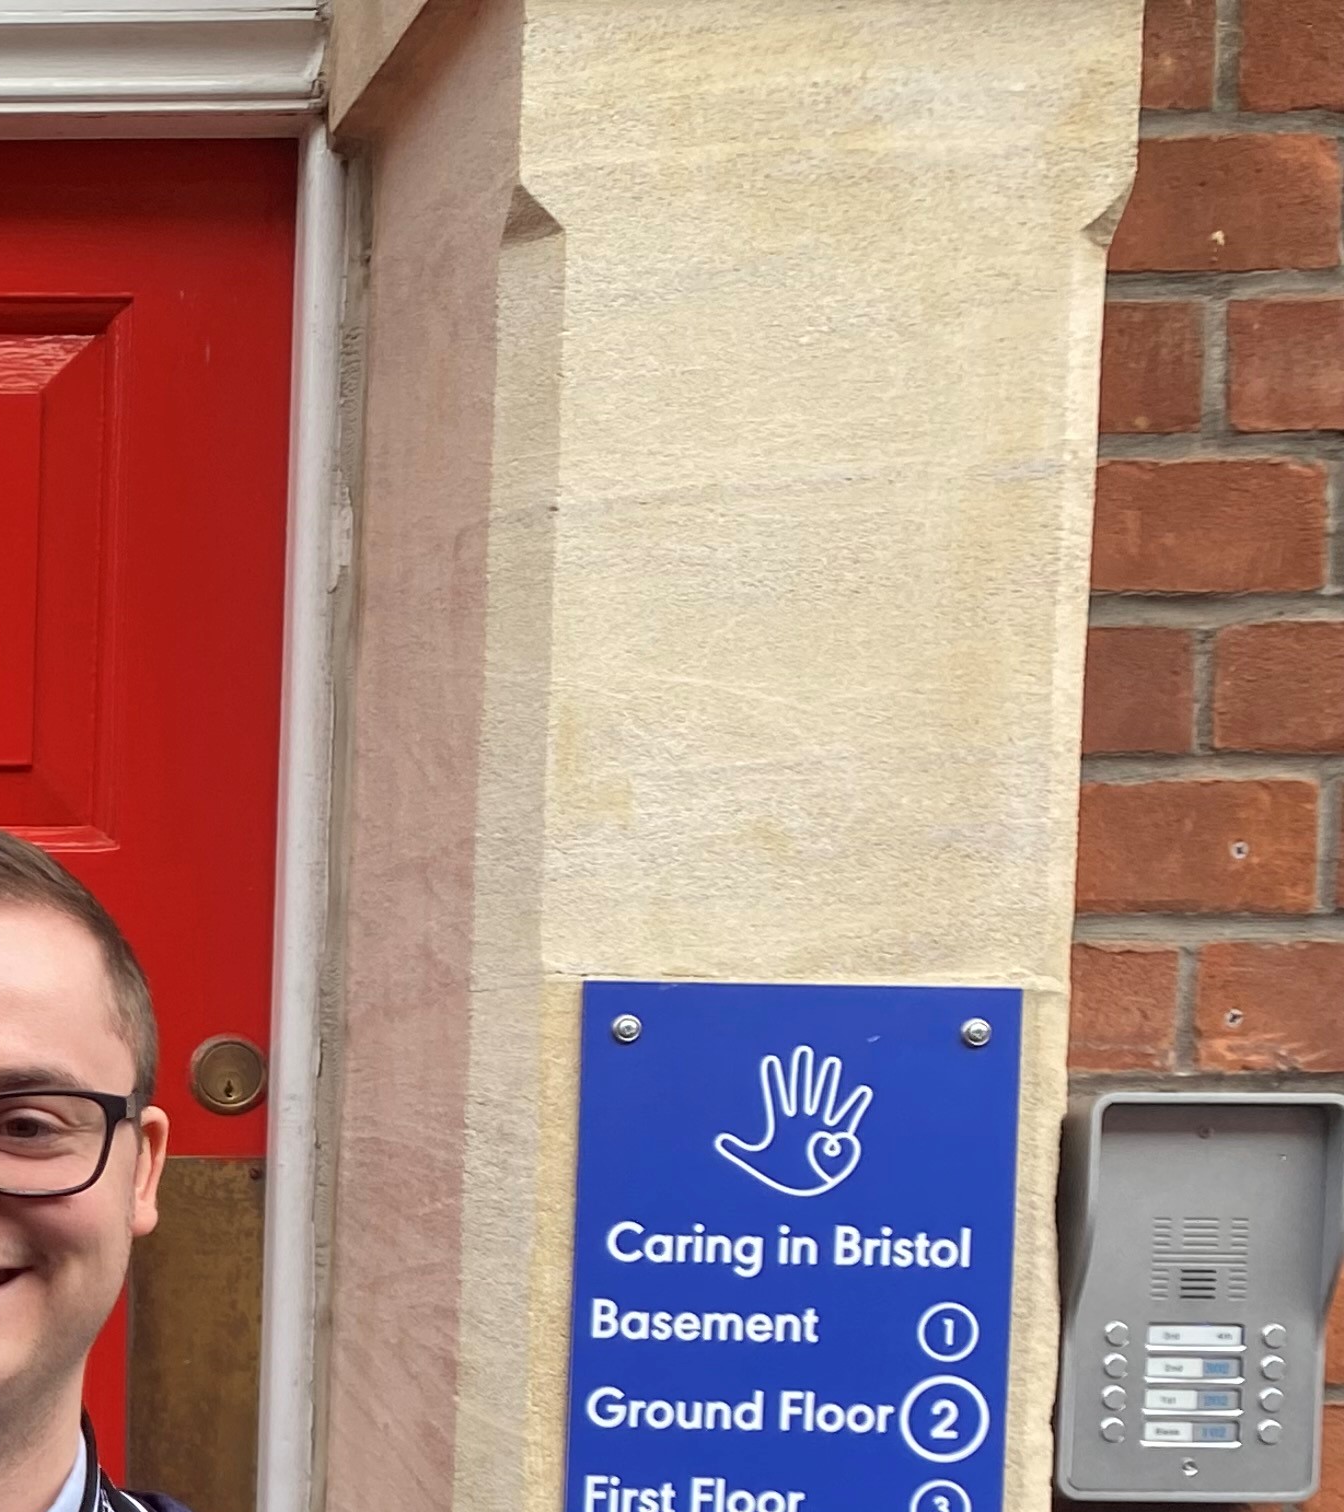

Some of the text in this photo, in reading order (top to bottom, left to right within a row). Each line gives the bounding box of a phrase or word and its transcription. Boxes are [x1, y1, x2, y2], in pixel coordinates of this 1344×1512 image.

[606, 1221, 972, 1278] Caring in Bristol
[591, 1298, 819, 1343] Basement
[586, 1386, 960, 1440] Ground Floor 2
